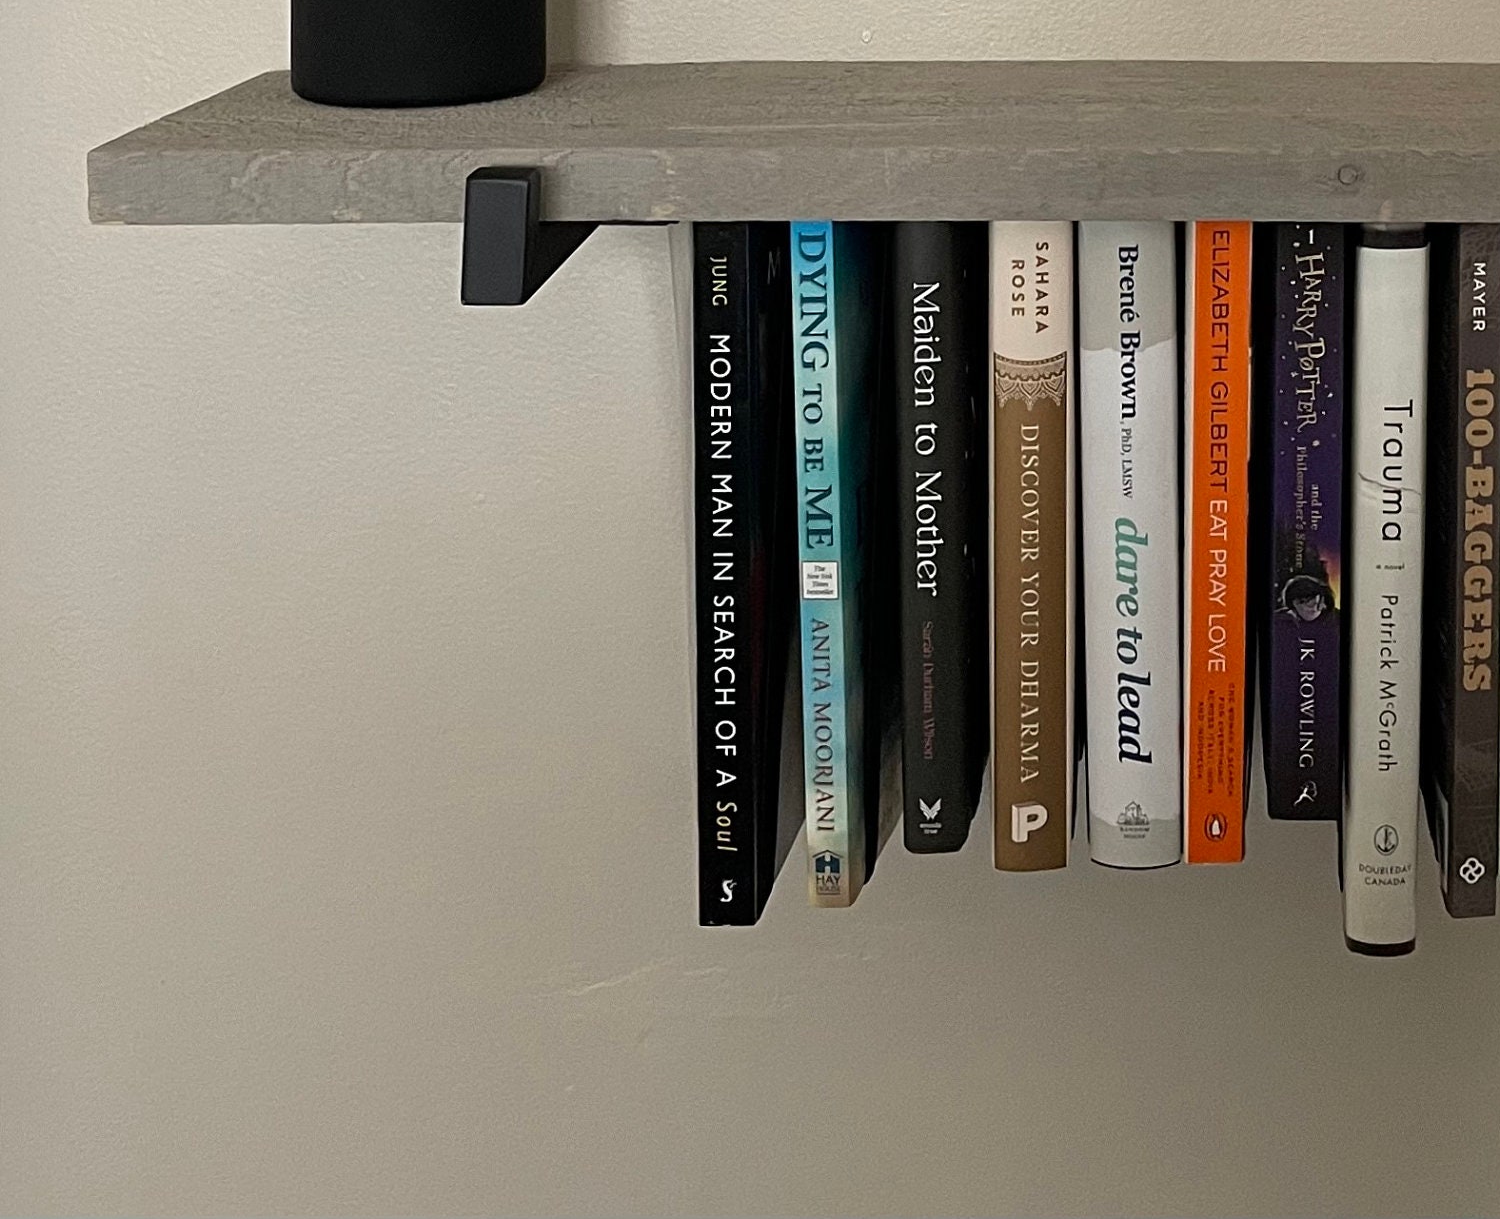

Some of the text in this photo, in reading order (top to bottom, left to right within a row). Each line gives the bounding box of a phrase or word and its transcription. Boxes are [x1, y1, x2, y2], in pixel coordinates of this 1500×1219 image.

[710, 257, 727, 306] JUNG
[1011, 260, 1025, 317] ROSE
[1035, 242, 1049, 334] SAHARA
[1292, 253, 1326, 432] HARRY POTTER
[1473, 263, 1486, 331] MAYER
[798, 232, 833, 549] DYING TO BE ME
[1118, 245, 1140, 499] Brené Brown, PhD, LMSW
[1210, 230, 1229, 493] ELIZABETH GILBERT
[913, 282, 943, 596] Maiden to Mother
[1294, 446, 1307, 529] Philosopher's
[1311, 484, 1322, 530] and the
[1382, 400, 1413, 541] Trauma
[710, 335, 737, 851] MODERN MAN IN SEARCH OF A Soul
[1208, 500, 1227, 672] EAT PRAY LOVE
[1462, 369, 1494, 691] 100-BAGGERS
[811, 619, 830, 691] ANITA
[1020, 424, 1039, 783] DISCOVER YOUR DHARMA
[1115, 518, 1152, 764] dare to lead
[1298, 672, 1314, 768] ROWLING
[1378, 595, 1398, 772] Patrick McGrath
[812, 703, 834, 832] MOORJANI
[816, 875, 840, 884] HAY
[1364, 876, 1406, 886] CANADA
